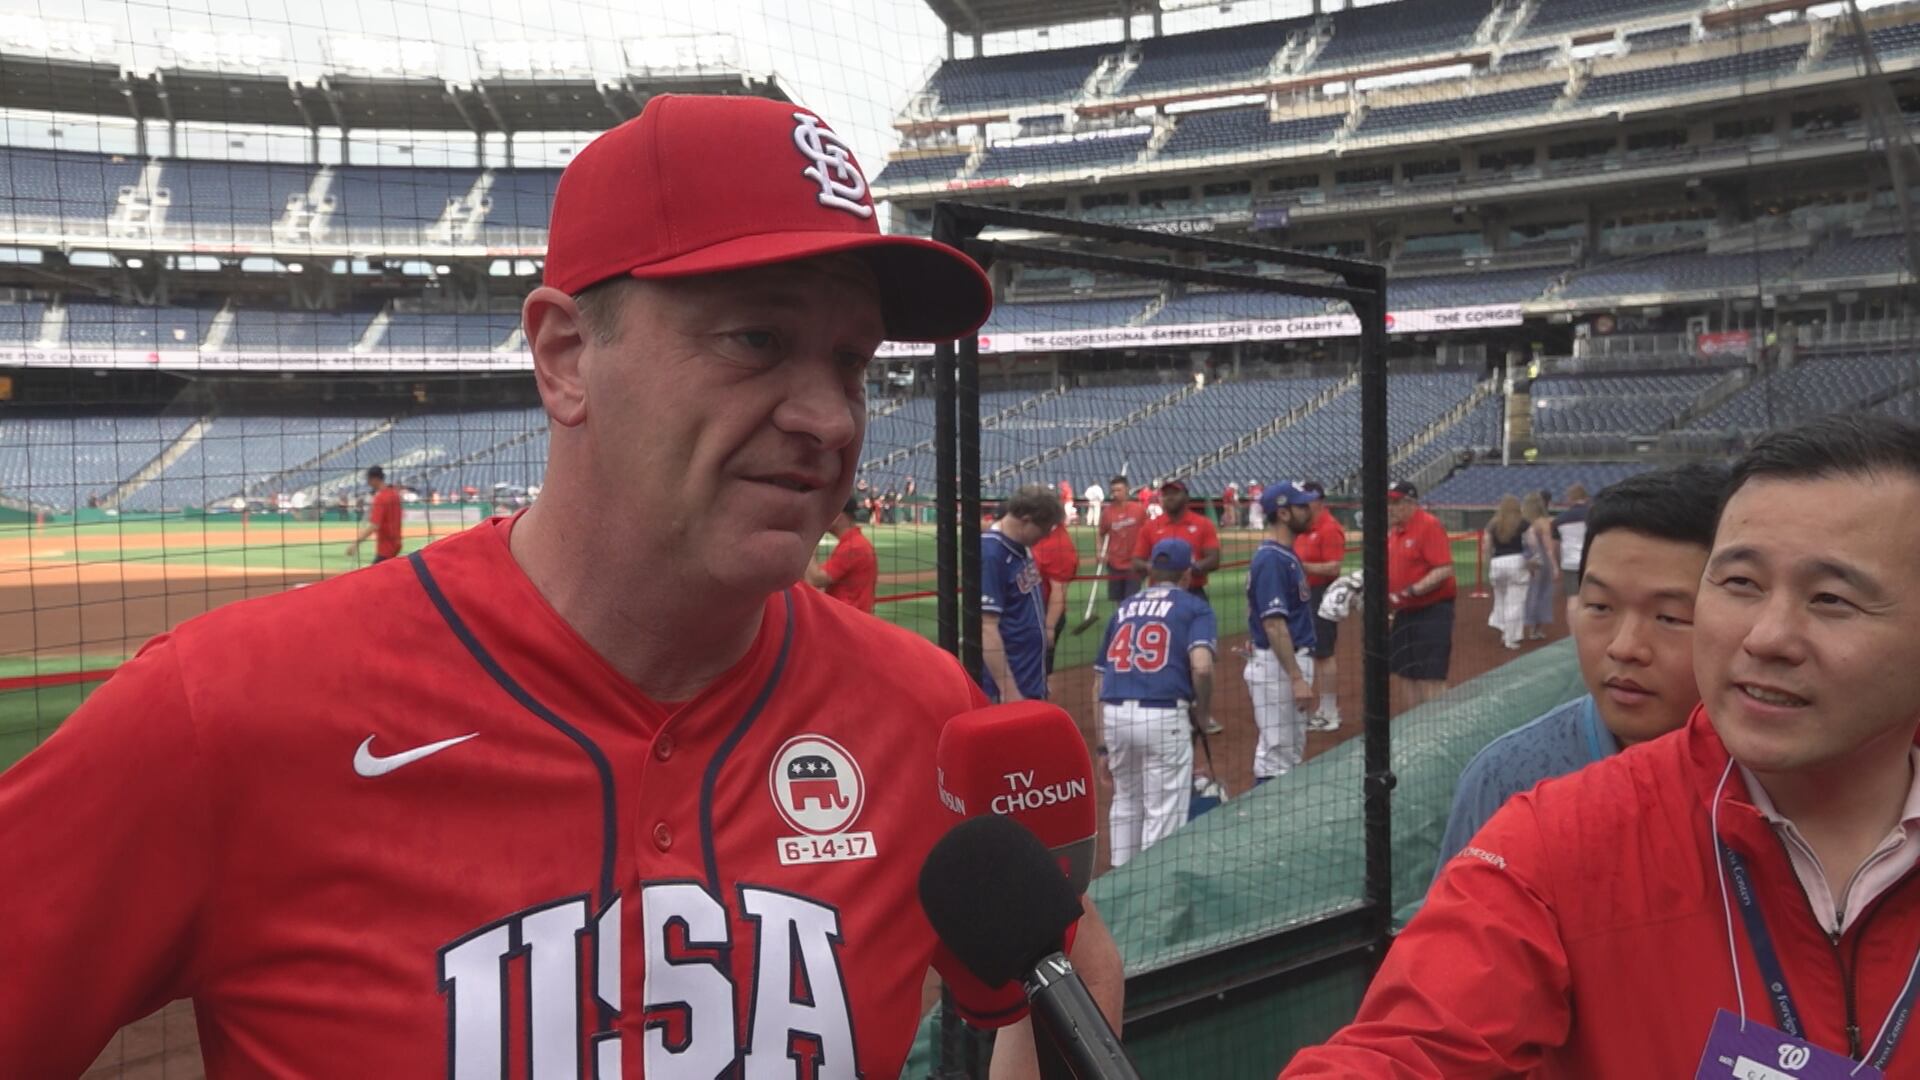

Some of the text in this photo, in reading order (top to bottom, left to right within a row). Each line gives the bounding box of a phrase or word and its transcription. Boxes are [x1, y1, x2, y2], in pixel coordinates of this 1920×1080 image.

[1434, 313, 1461, 324] THE
[1024, 320, 1343, 346] THE CONGRESSIONAL BASEBALL GAME FOR CHARITY
[50, 353, 108, 362] CHARITY
[1117, 599, 1174, 624] LEVIN
[1106, 621, 1171, 673] 49
[1003, 769, 1035, 792] TV
[990, 777, 1087, 815] CHOSUN
[784, 837, 868, 862] 6-14-17
[437, 879, 866, 1080] USA
